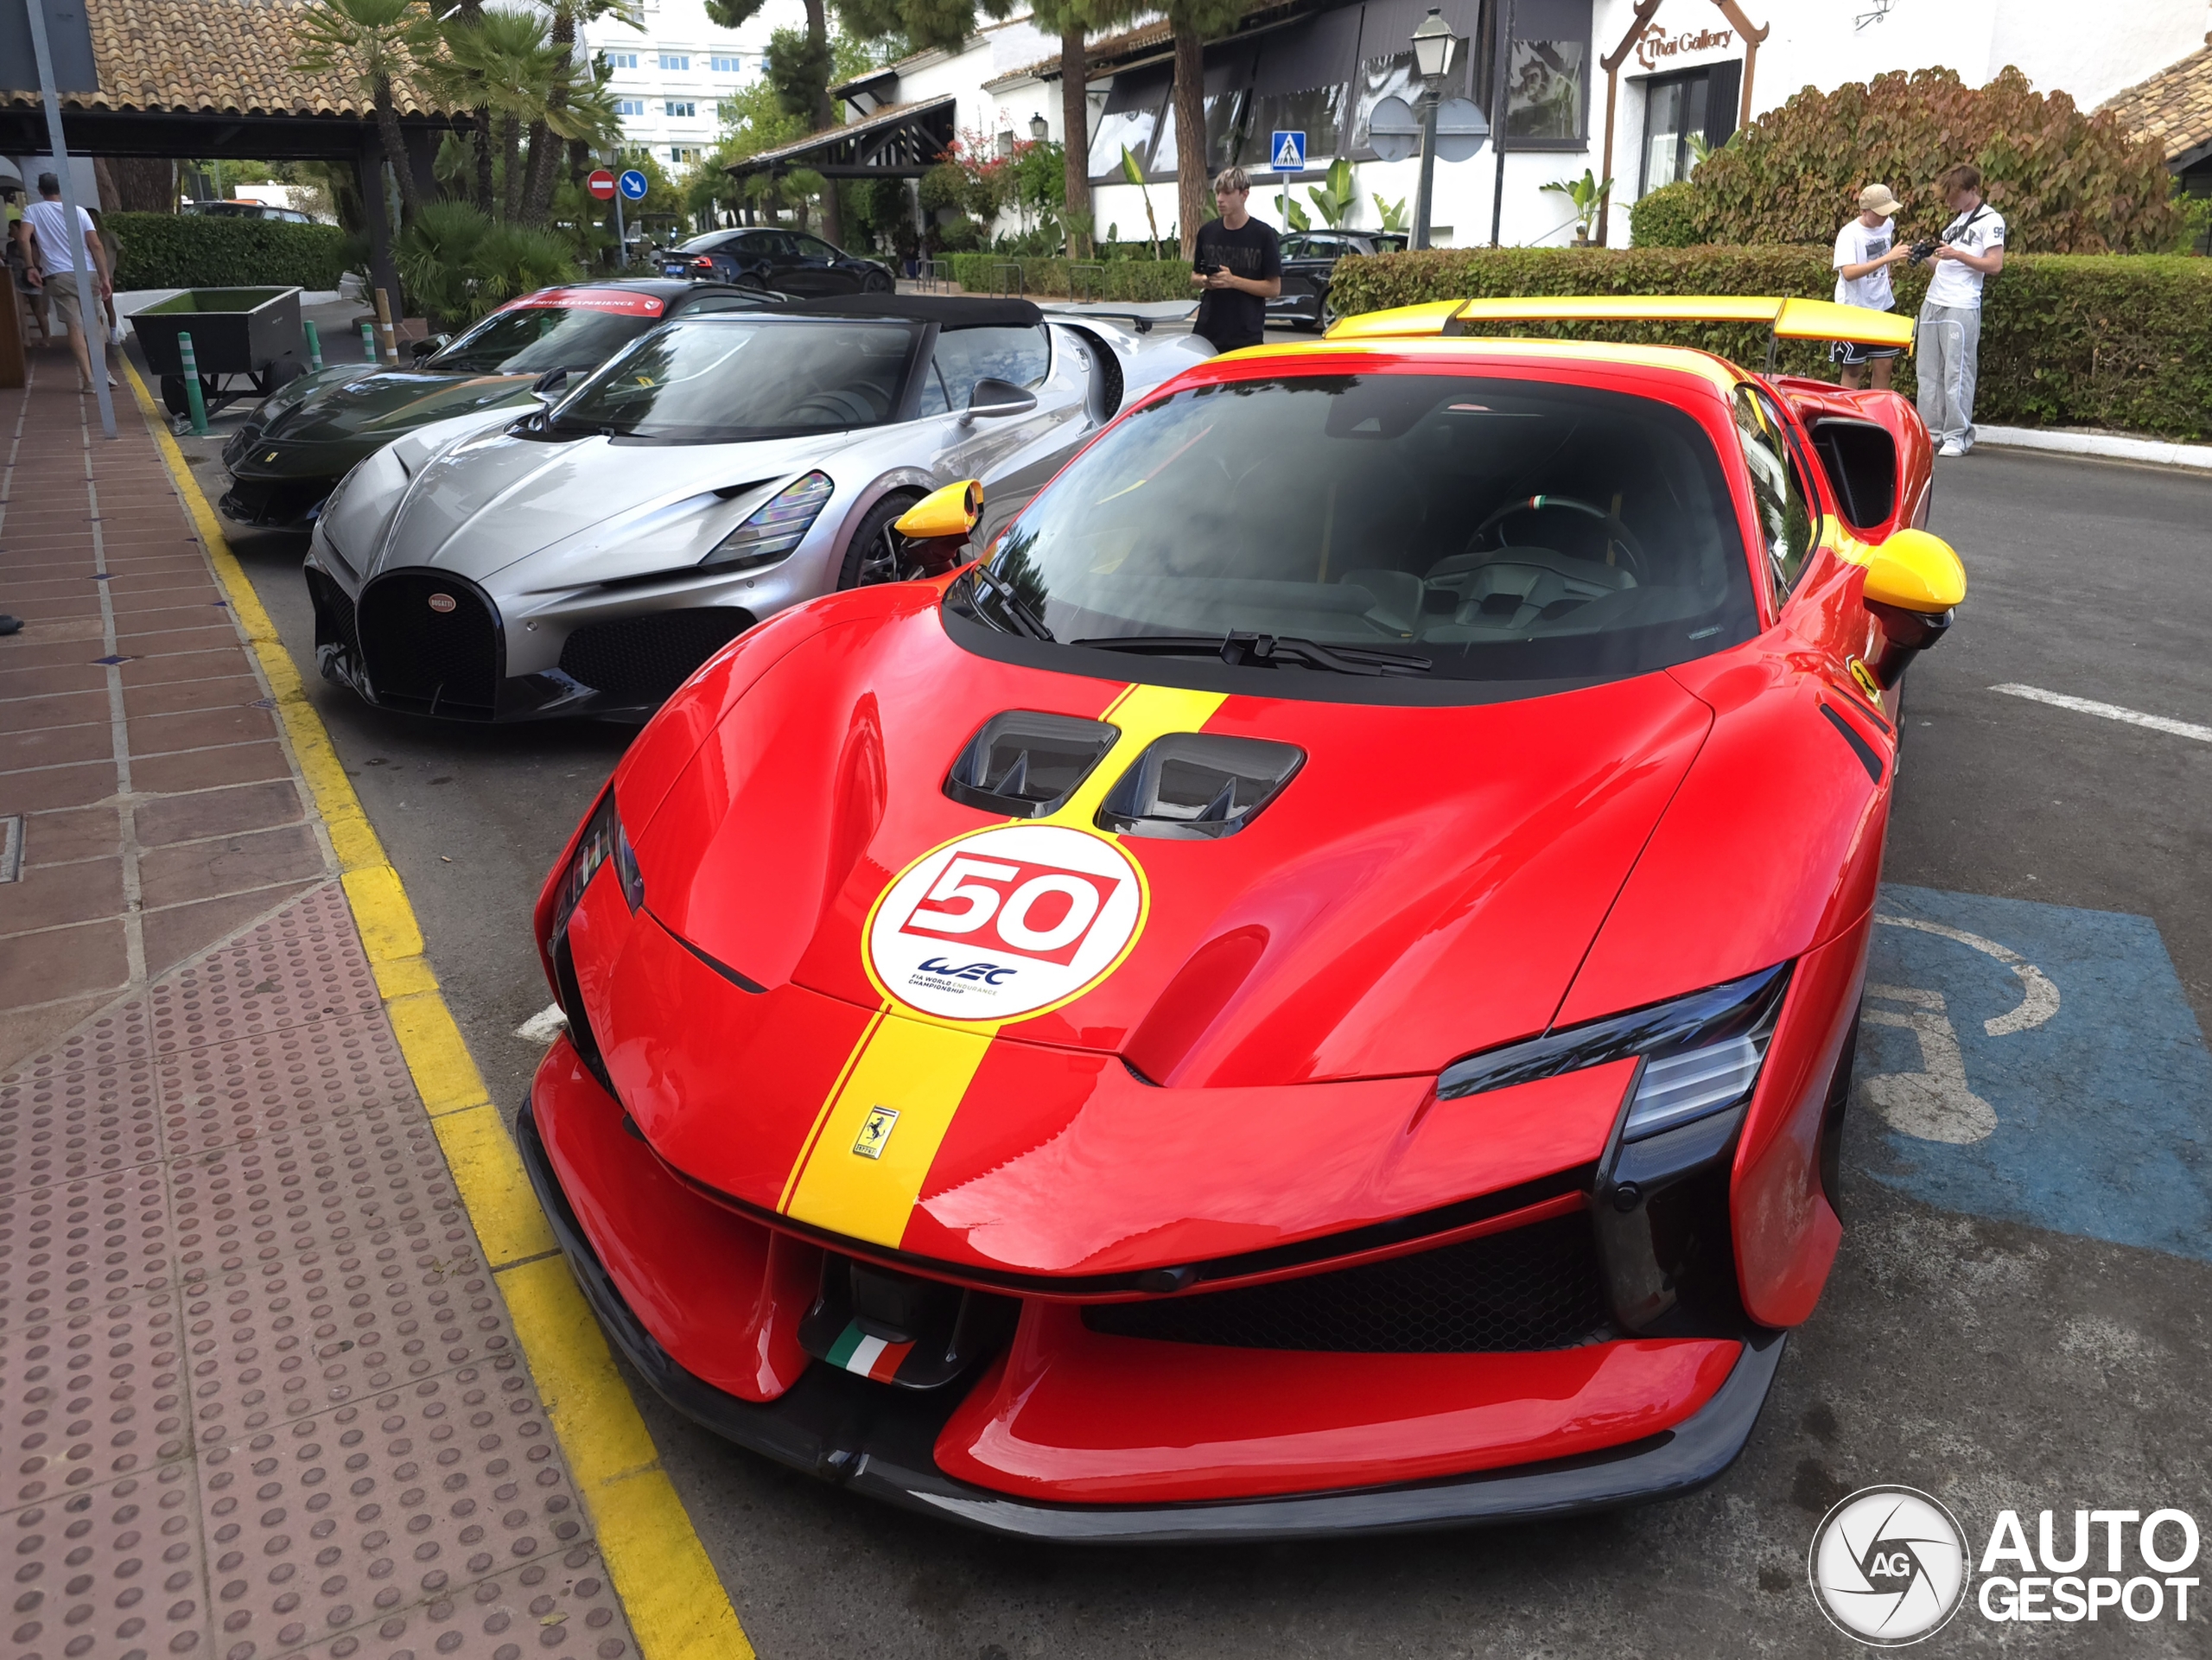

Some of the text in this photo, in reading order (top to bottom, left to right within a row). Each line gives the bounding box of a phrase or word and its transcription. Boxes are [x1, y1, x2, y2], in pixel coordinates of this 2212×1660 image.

[1647, 29, 1733, 58] Thai Gallery
[907, 857, 1100, 951] 50
[918, 957, 1018, 985] WEC
[908, 979, 964, 995] CHAMPIONSHIP
[925, 976, 952, 986] WORLD
[952, 983, 998, 996] ENDURANCE
